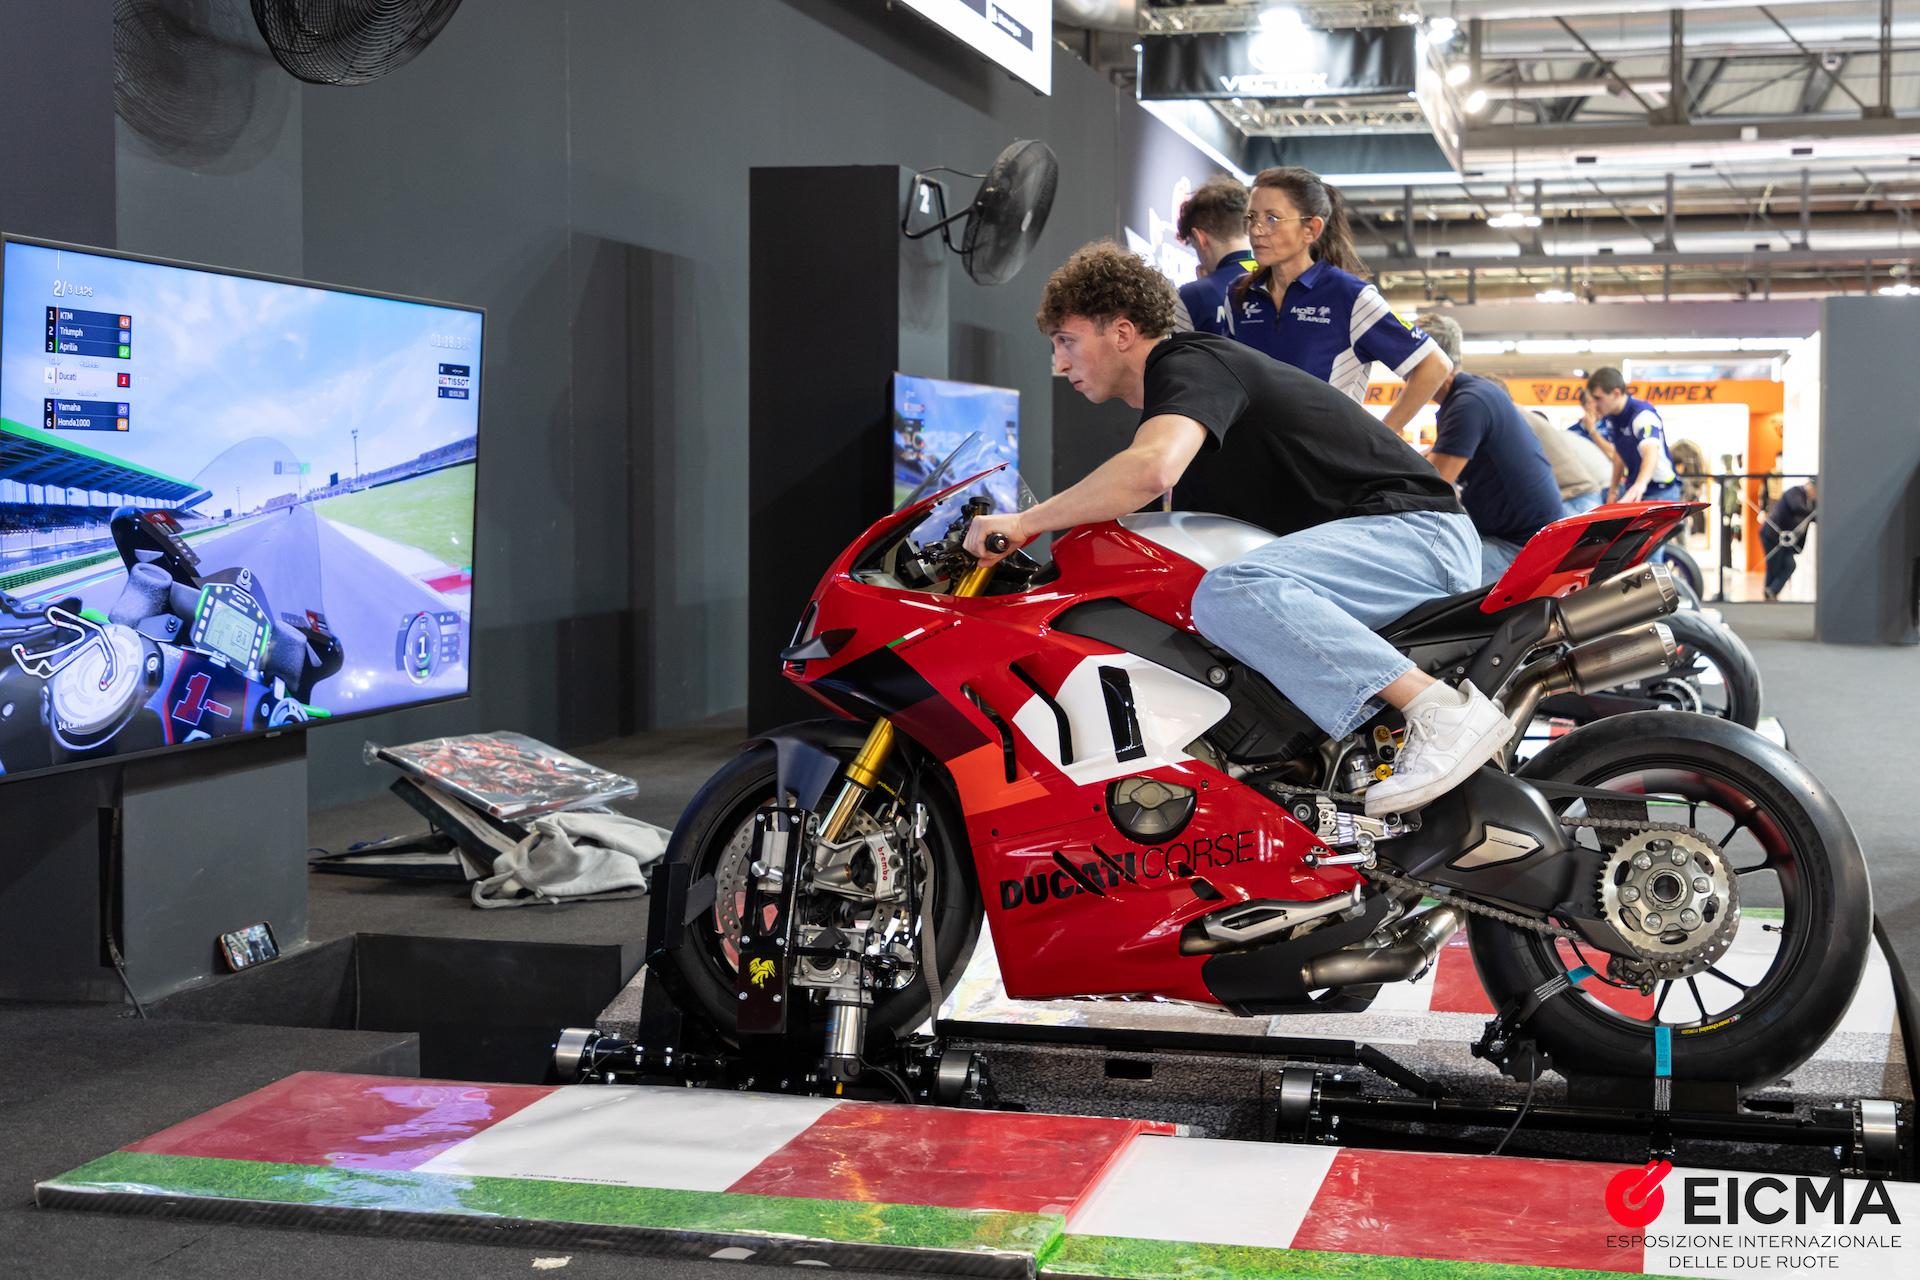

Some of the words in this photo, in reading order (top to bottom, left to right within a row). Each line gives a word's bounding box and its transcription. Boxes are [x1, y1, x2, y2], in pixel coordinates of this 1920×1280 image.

[919, 183, 930, 214] 2
[75, 285, 93, 297] LAPS
[1290, 306, 1316, 316] MOTO
[48, 310, 54, 320] 1
[60, 311, 73, 321] KTM
[121, 318, 129, 327] 43
[1297, 313, 1331, 325] TRAINER
[48, 325, 54, 336] 2
[60, 326, 83, 338] Triumph
[48, 341, 53, 351] 3
[59, 342, 78, 352] Aprilia
[120, 348, 129, 356] 12
[59, 371, 77, 381] Ducati
[121, 376, 127, 385] 1
[448, 377, 469, 387] TISSOT
[1646, 385, 1717, 402] IMPEX
[47, 402, 52, 411] 5
[58, 402, 81, 412] Yamaha
[119, 405, 127, 414] 20
[46, 418, 52, 427] 6
[57, 418, 91, 428] Honda1000
[119, 420, 127, 429] 10
[418, 636, 427, 658] 1
[877, 846, 890, 881] brembo
[1000, 850, 1136, 911] DUCATI
[1142, 829, 1255, 880] CORSE
